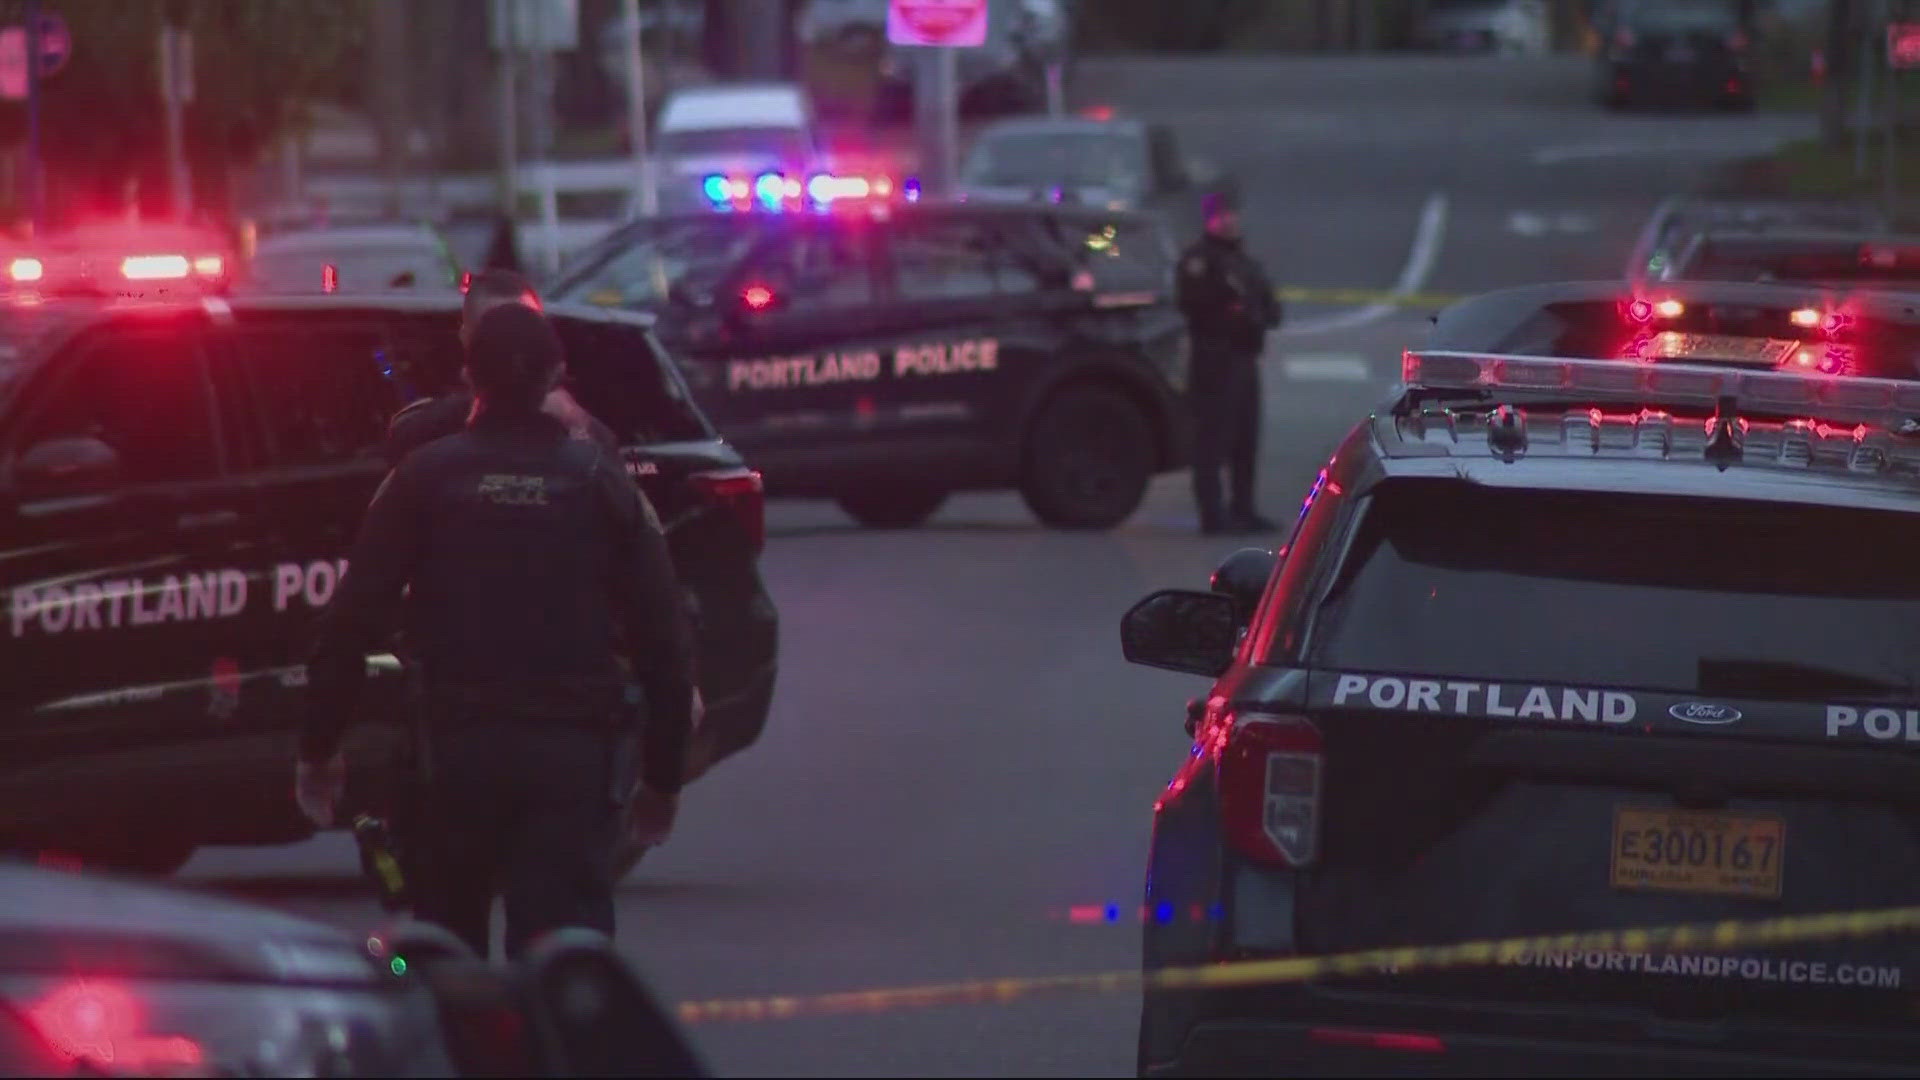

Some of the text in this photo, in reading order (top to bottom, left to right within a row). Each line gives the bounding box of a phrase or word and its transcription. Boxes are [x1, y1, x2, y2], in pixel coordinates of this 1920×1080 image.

[729, 338, 998, 393] PORTLAND POLICE
[11, 567, 248, 639] PORTLAND
[1332, 673, 1638, 724] PORTLAND
[1621, 826, 1777, 872] E300167
[1503, 945, 1902, 988] OINPORTLANDPOLICE.COM
